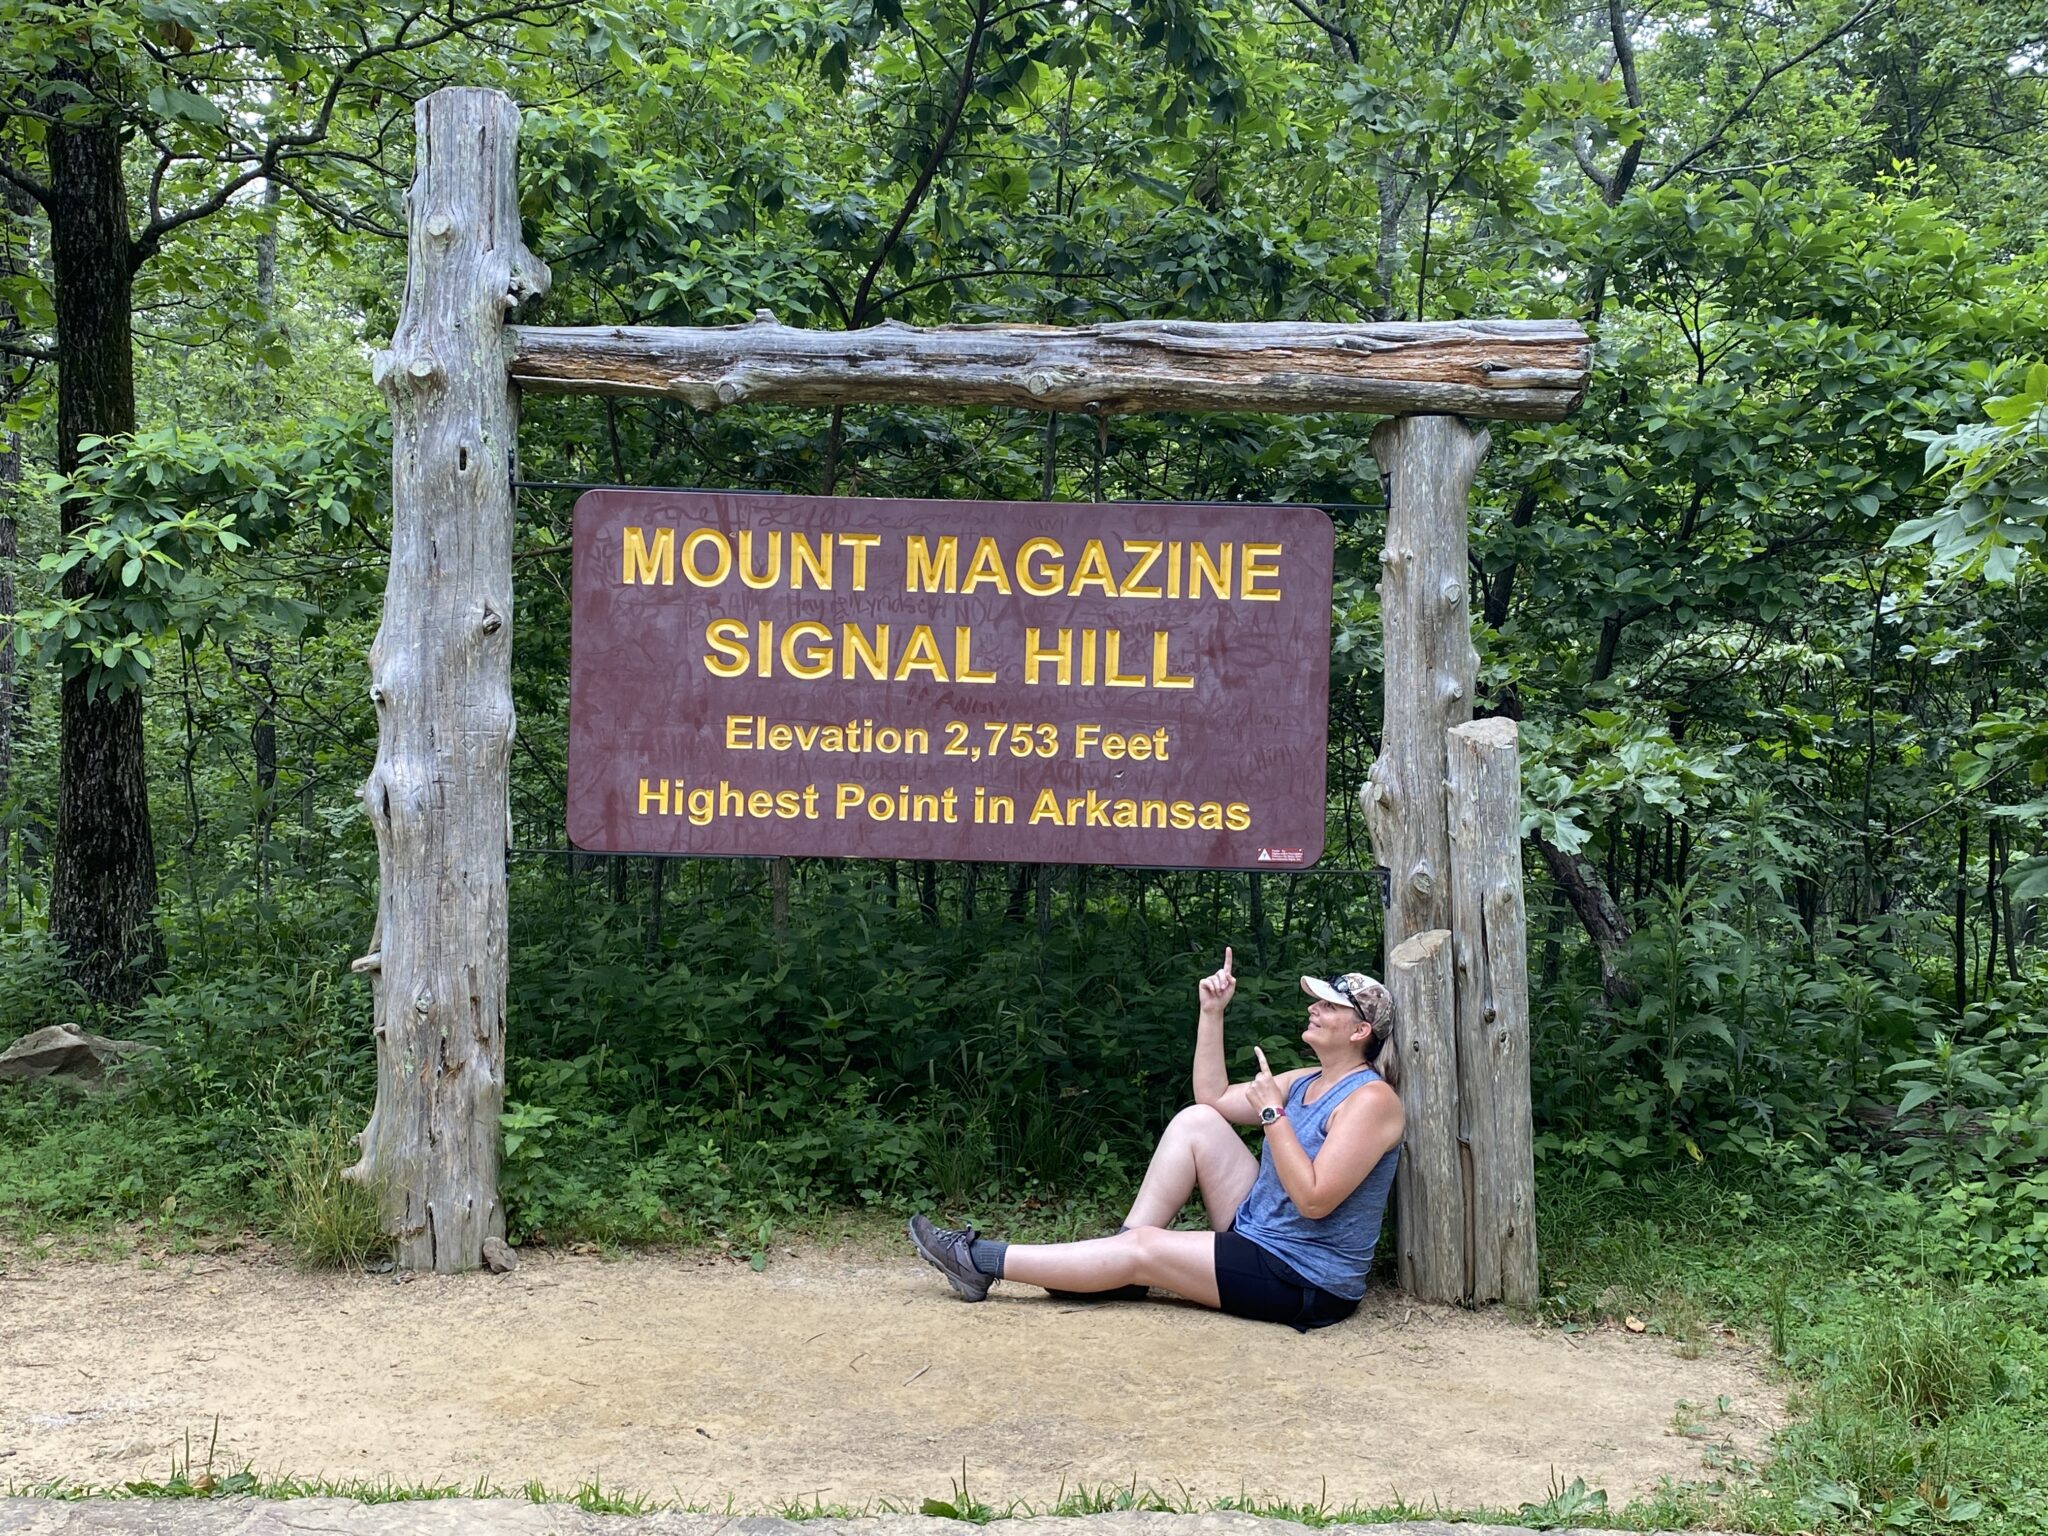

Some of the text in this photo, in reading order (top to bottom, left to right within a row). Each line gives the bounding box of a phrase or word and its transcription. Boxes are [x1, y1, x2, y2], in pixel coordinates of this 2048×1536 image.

[621, 526, 1284, 602] MOUNT MAGAZINE
[702, 617, 1196, 689] SIGNAL HILL
[724, 714, 1170, 763] Elevation 2,753 Feet
[637, 777, 1253, 832] Highest Point in Arkansas
